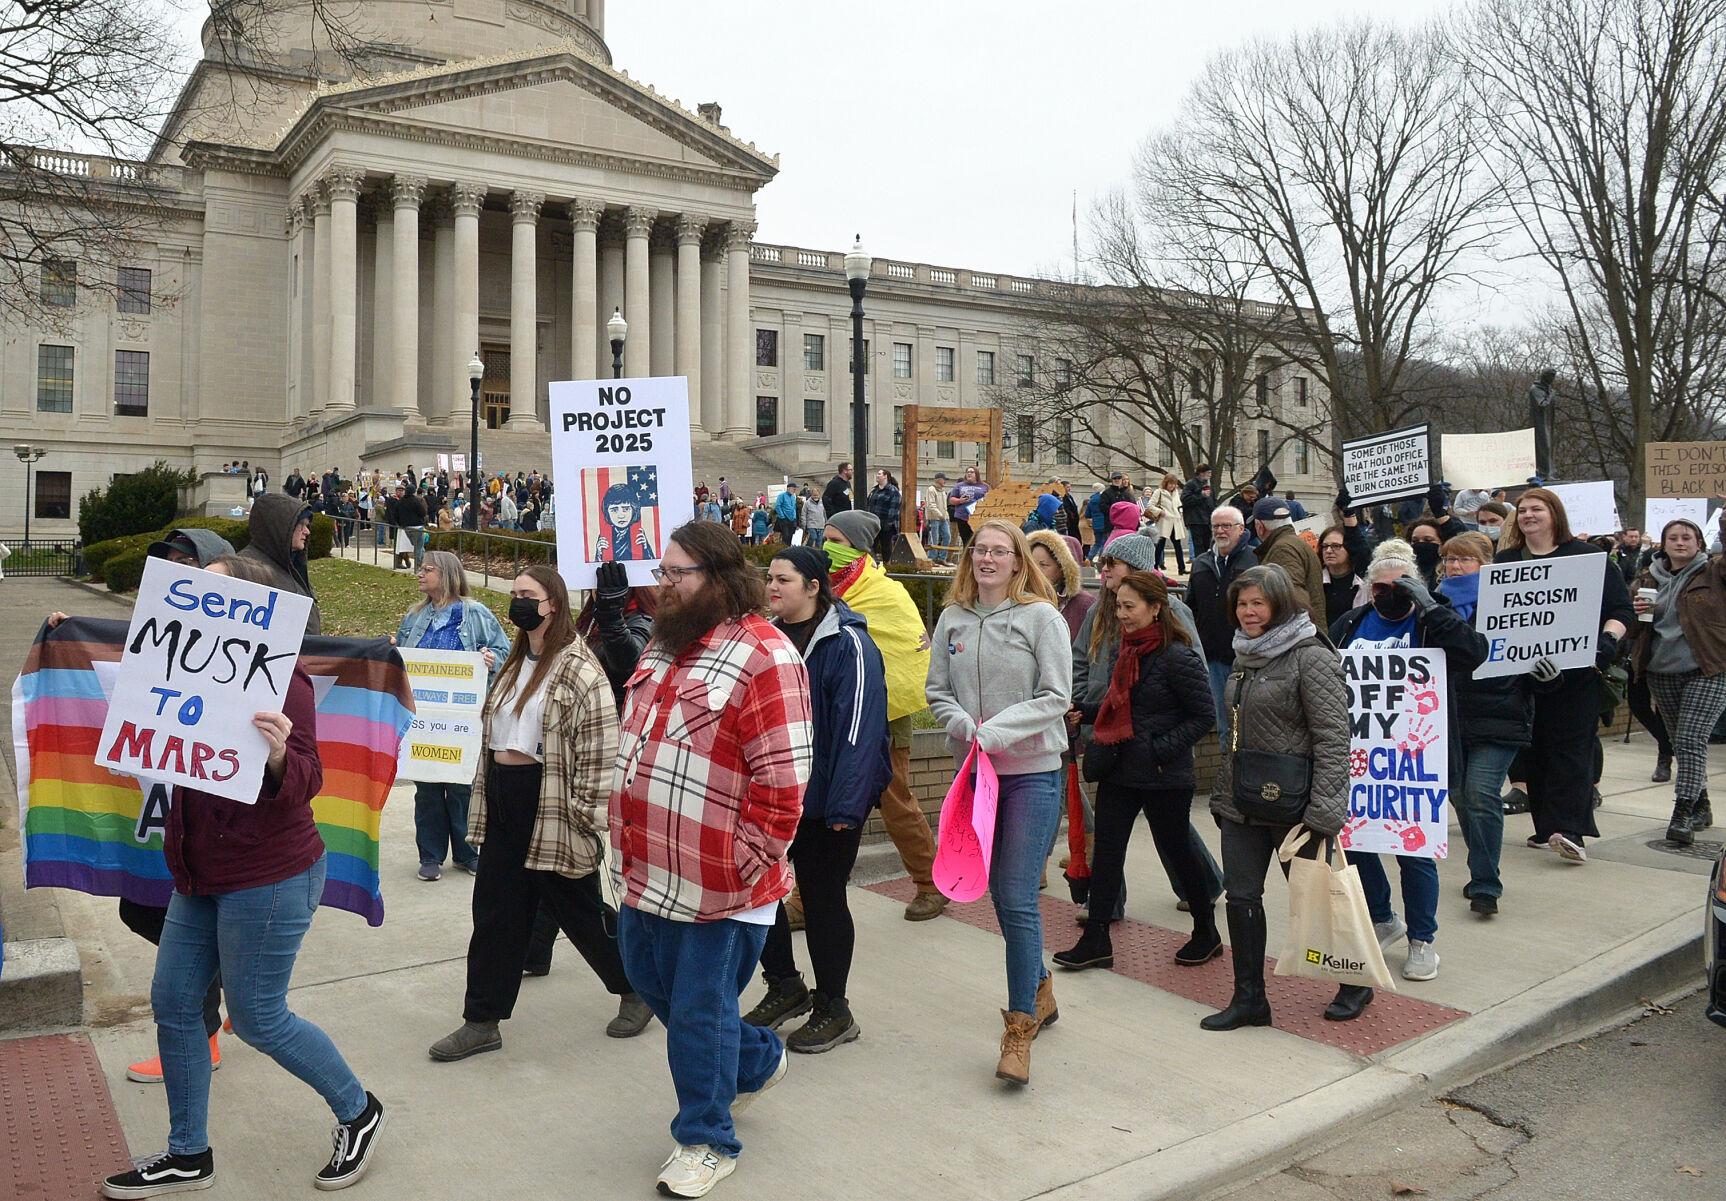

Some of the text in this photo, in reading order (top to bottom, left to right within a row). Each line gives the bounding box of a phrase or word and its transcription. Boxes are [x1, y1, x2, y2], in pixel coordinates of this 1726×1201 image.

[598, 387, 632, 406] NO
[563, 408, 666, 432] PROJECT
[596, 433, 653, 453] 2025
[1351, 438, 1417, 460] SOME OF THOSE
[1654, 446, 1726, 462] I DON'T
[1347, 448, 1424, 472] THAT HOLD OFFICE
[1650, 462, 1726, 476] THIS EPISO
[1345, 460, 1429, 483] ARE THE SAME THAT
[1354, 473, 1420, 494] BURN CROSSES
[1661, 479, 1706, 495] BLACK
[1490, 564, 1552, 586] REJECT
[164, 579, 279, 630] Send
[1503, 587, 1578, 609] FASCISM
[1486, 610, 1555, 631] DEFEND
[129, 617, 296, 696] MUSK
[1488, 635, 1589, 663] EQUALITY!
[406, 664, 474, 677] UNTAINEERS
[1341, 654, 1431, 685] ANDS
[150, 686, 204, 726] TO
[413, 690, 477, 704] ALWAYS FREE
[430, 720, 447, 731] you
[454, 723, 469, 733] are
[1350, 712, 1399, 740] MY
[107, 720, 240, 782] MARS
[411, 745, 462, 761] WOMEN!
[1350, 746, 1439, 782] OCIAL
[1347, 783, 1448, 824] CURITY
[1322, 953, 1366, 971] Keller
